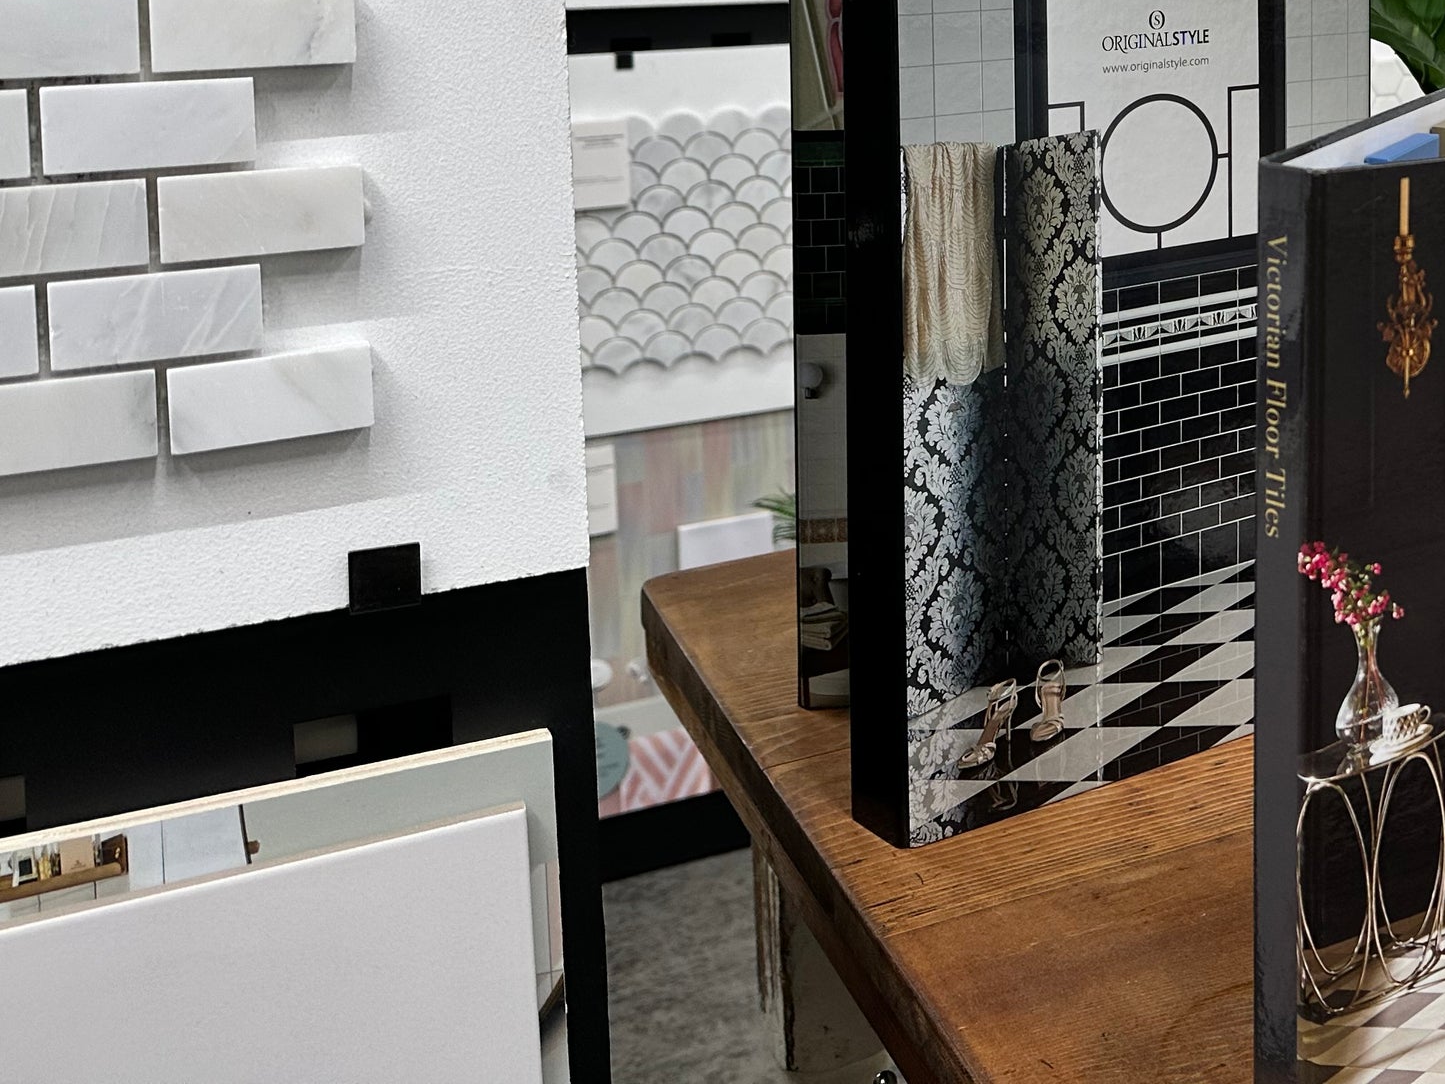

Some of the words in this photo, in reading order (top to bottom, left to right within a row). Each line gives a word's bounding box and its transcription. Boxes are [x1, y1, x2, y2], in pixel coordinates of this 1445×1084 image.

[1102, 57, 1210, 74] www.originalstyle.com
[1265, 234, 1288, 369] Victorian
[1265, 378, 1287, 460] Floor
[1264, 468, 1286, 539] Tiles
